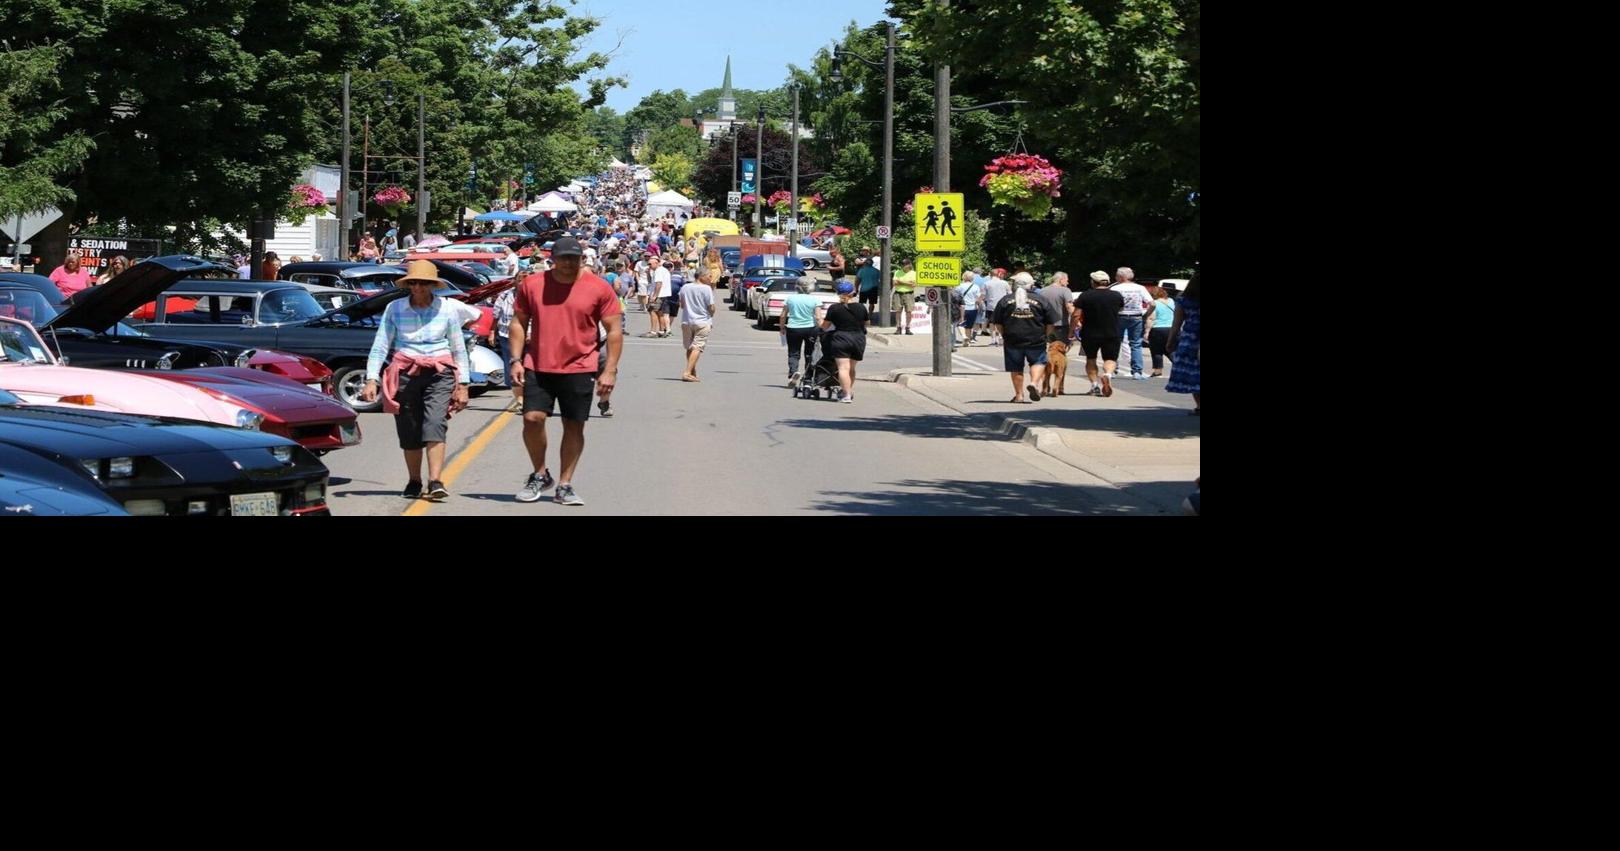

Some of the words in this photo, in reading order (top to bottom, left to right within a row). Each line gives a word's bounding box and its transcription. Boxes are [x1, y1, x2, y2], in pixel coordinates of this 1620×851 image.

[70, 238, 78, 248] &
[81, 240, 127, 250] SEDATION
[923, 262, 954, 270] SCHOOL
[919, 271, 958, 280] CROSSING
